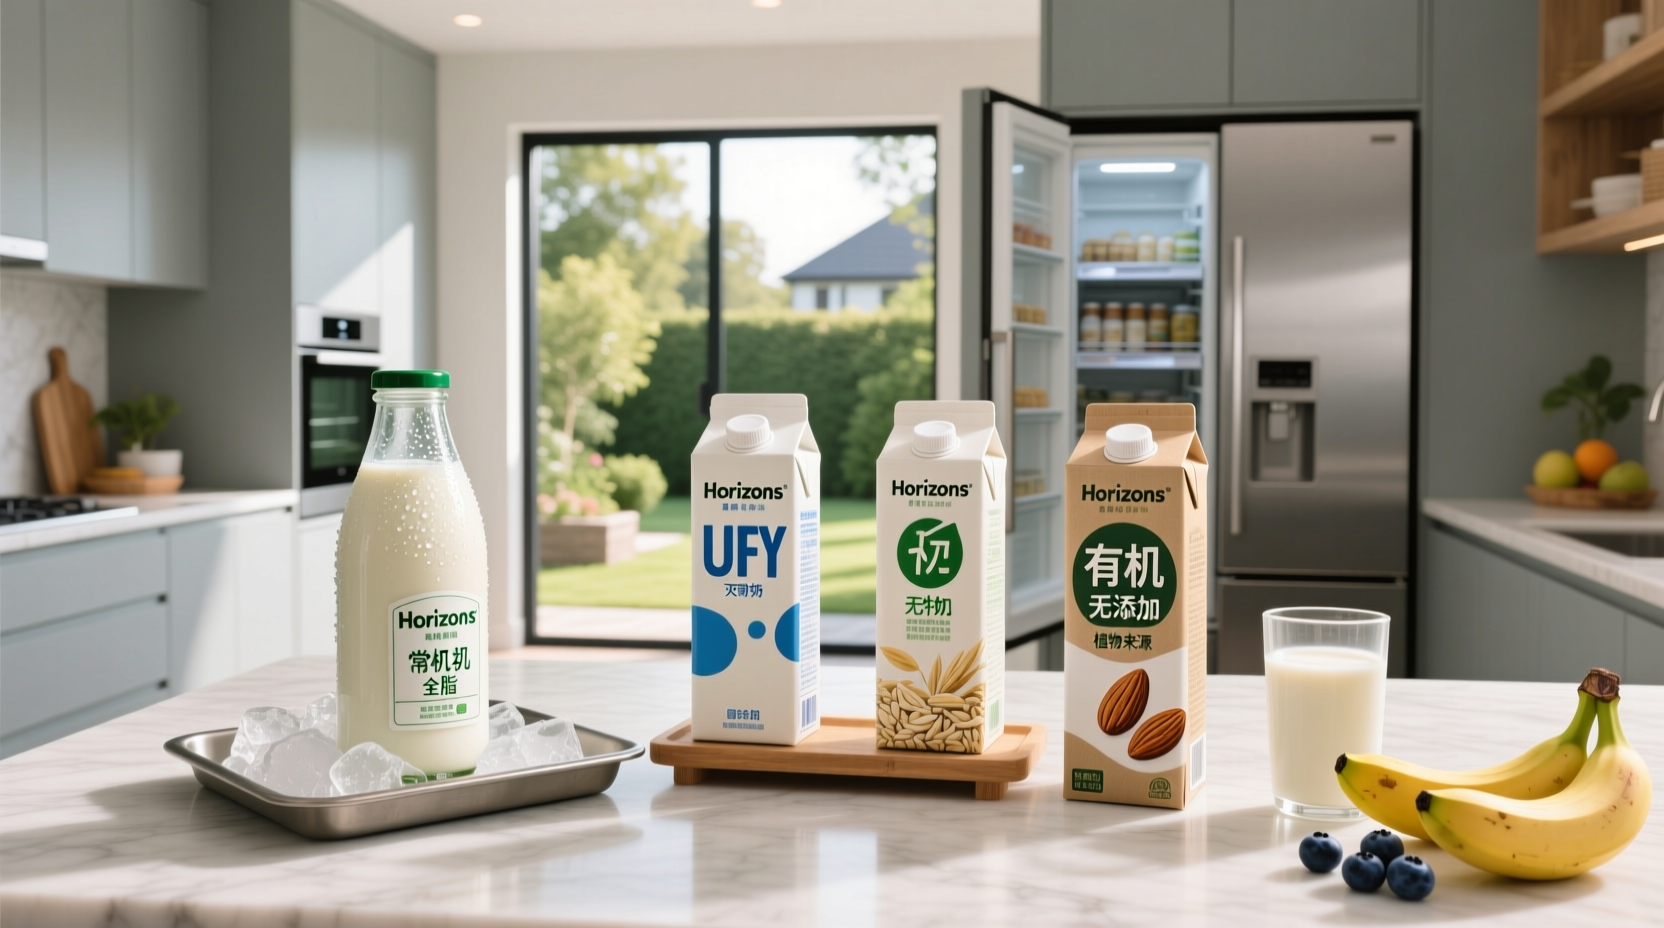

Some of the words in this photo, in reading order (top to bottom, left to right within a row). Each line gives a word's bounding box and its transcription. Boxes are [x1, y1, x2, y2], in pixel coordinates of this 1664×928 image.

[703, 524, 787, 578] UFY
[1084, 543, 1165, 589] 有机
[1089, 594, 1160, 621] 无添加
[423, 675, 458, 696] 全脂
